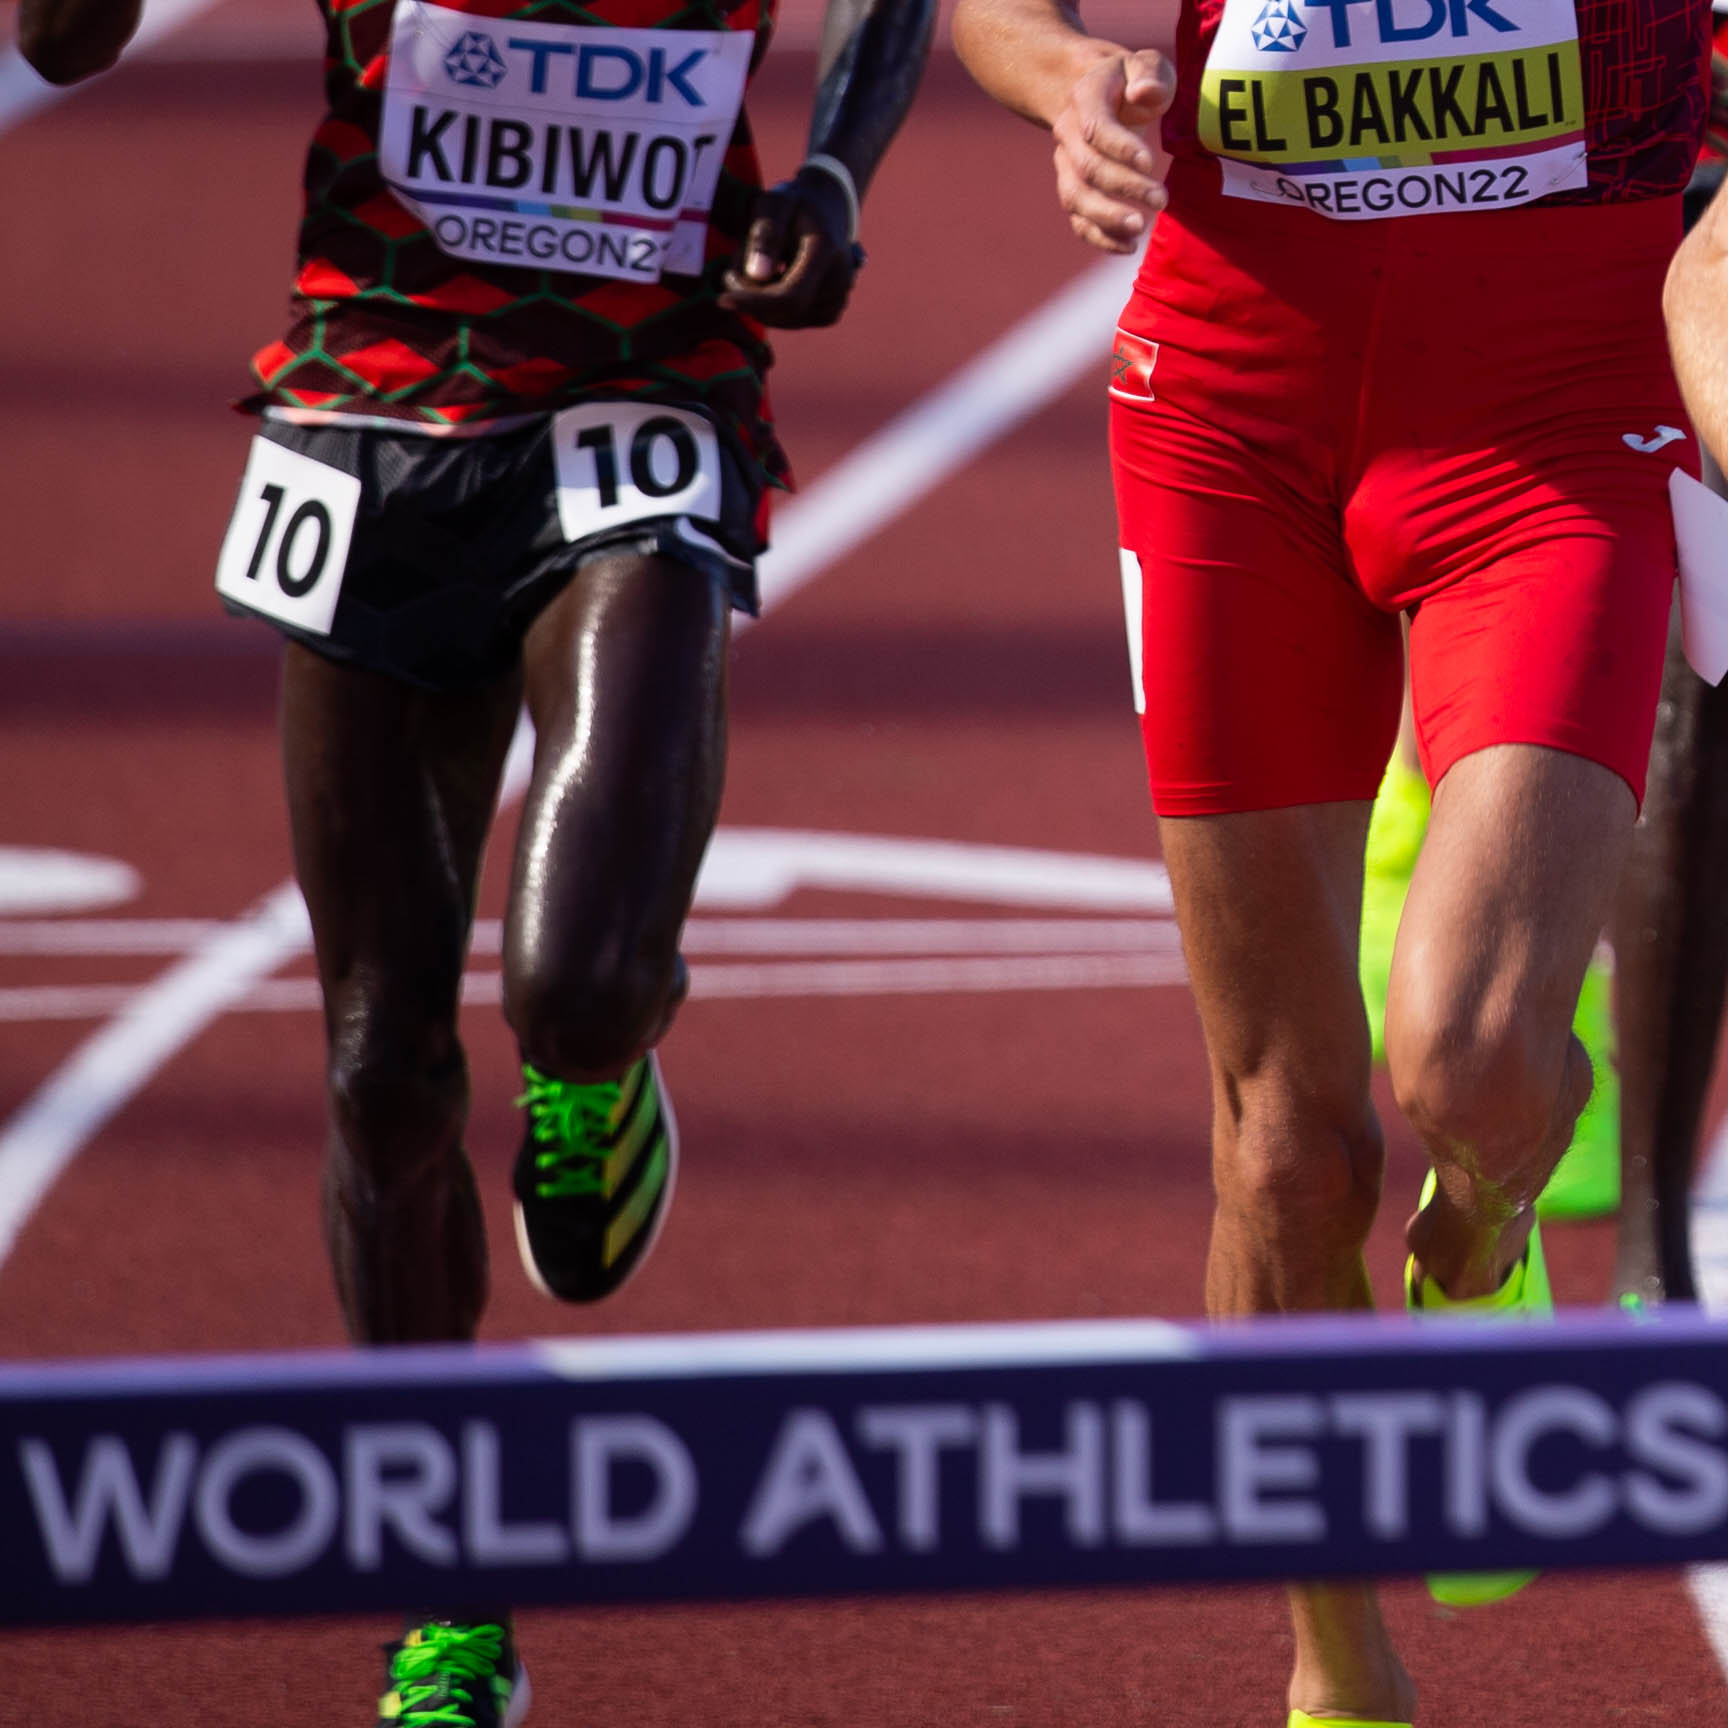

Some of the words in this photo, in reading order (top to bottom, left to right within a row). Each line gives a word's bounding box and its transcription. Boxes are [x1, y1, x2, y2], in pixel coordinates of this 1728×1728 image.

[506, 36, 709, 108] TDK
[1219, 78, 1288, 152] EL
[1303, 51, 1565, 150] BAKKALI
[1277, 164, 1530, 214] OREGON22
[434, 213, 672, 273] OREGON2
[576, 415, 700, 510] 10
[246, 482, 331, 599] 10
[20, 1414, 696, 1584] WORLD
